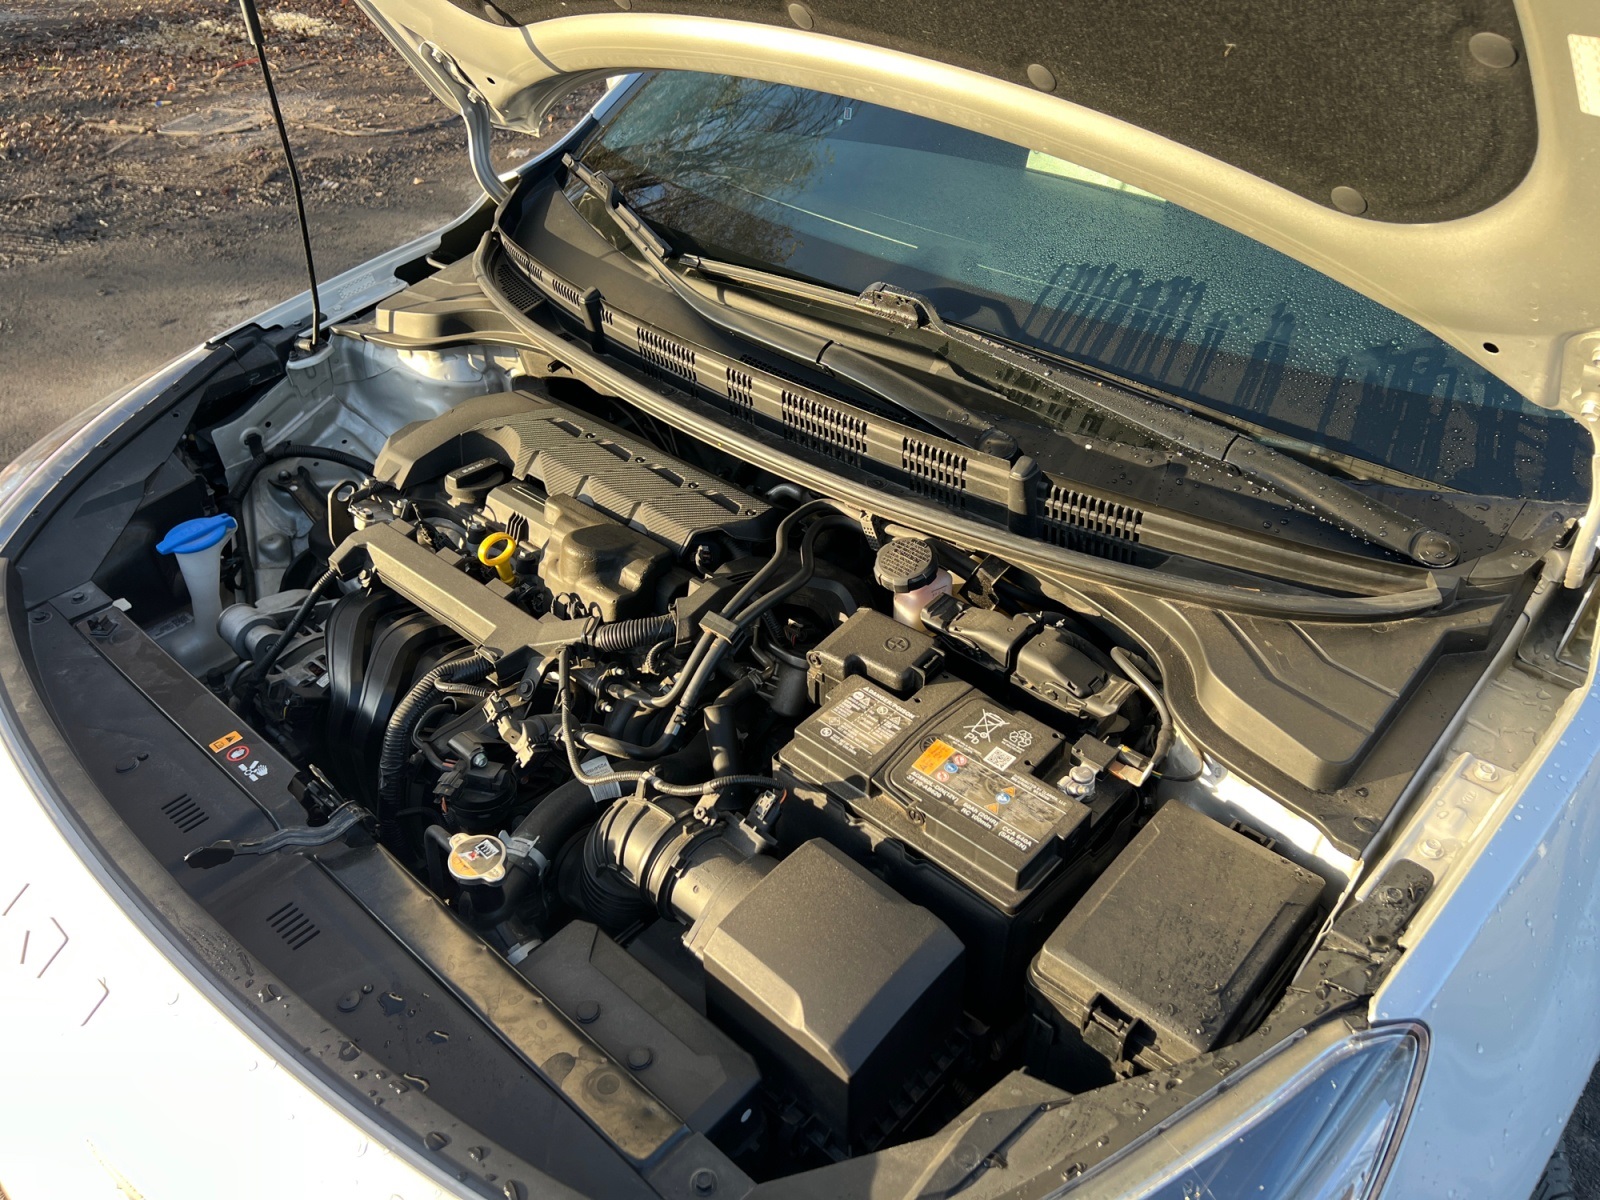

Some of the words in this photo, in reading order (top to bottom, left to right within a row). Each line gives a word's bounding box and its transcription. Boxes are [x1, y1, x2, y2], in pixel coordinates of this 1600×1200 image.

[964, 732, 980, 745] Pb
[961, 807, 971, 816] RC
[1002, 826, 1016, 837] CCA
